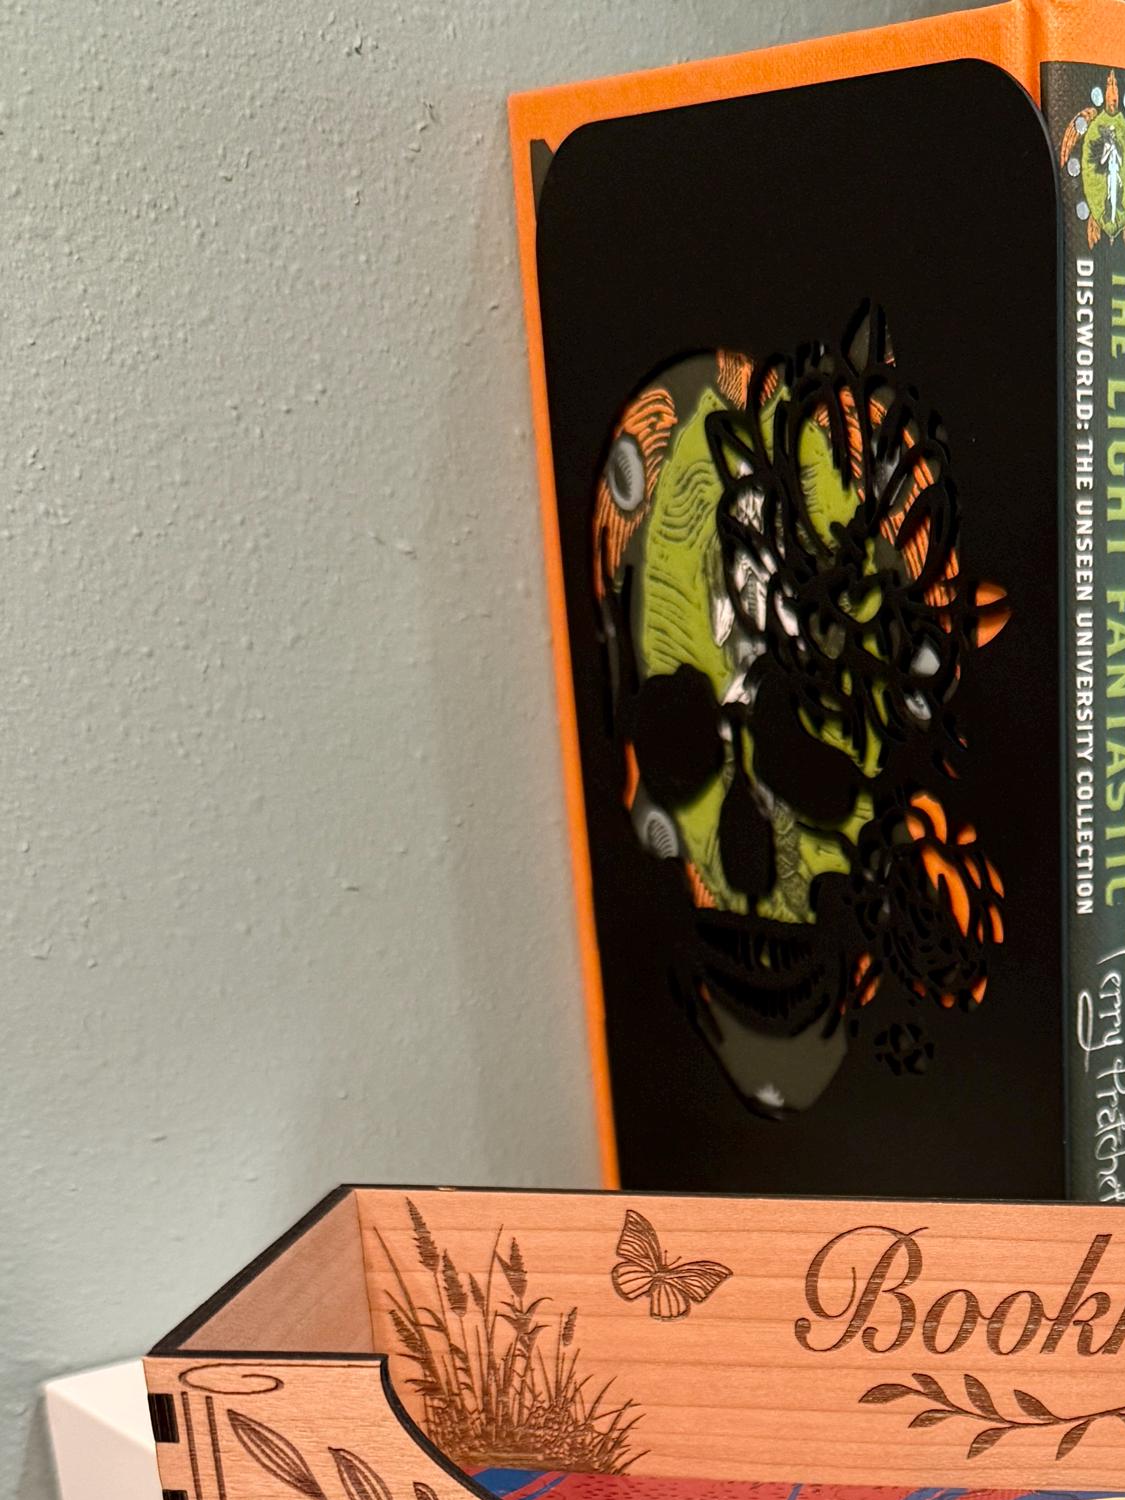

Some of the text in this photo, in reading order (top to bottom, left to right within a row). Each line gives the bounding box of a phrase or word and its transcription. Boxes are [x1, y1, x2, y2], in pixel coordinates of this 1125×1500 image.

[1076, 258, 1095, 914] DISCWORLD: THE UNSEEN UNIVERSITY COLLECTION
